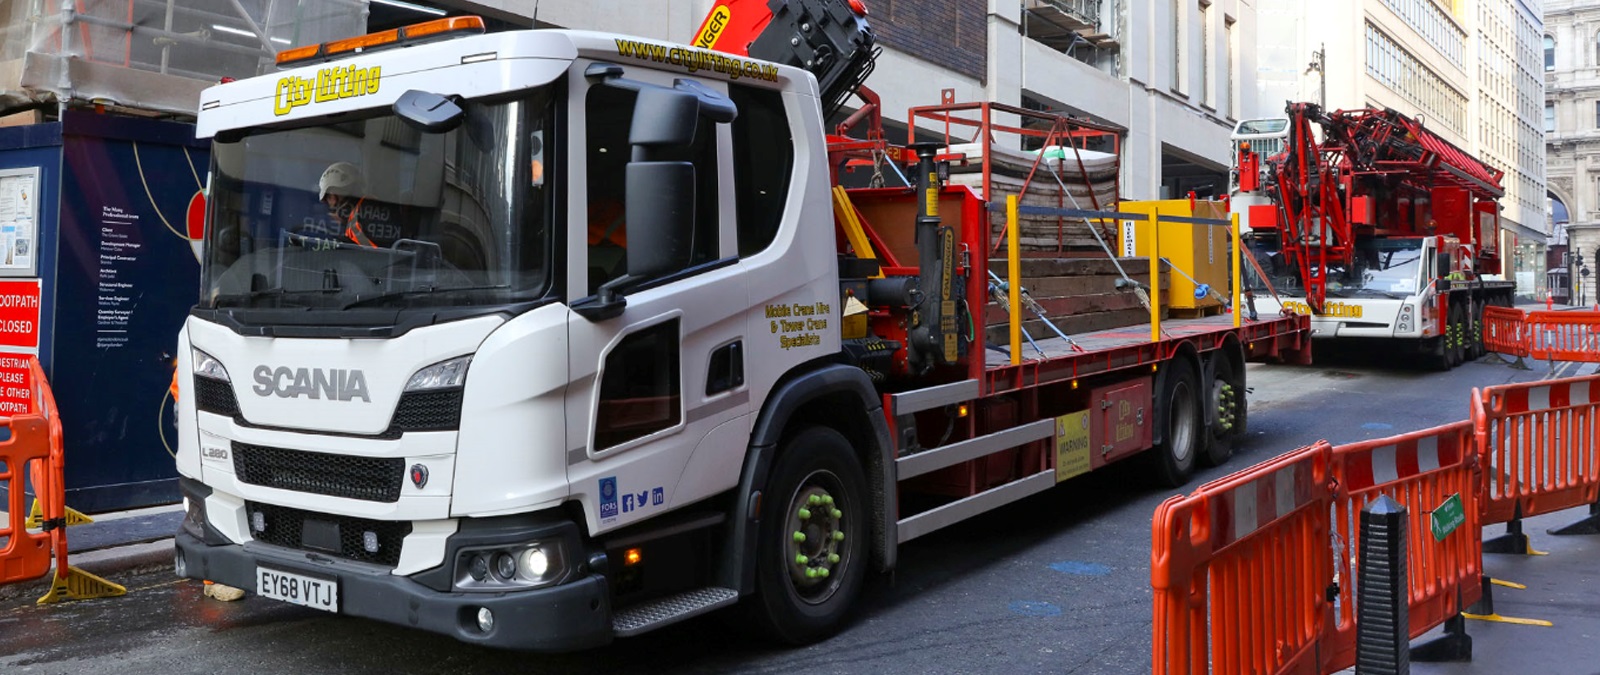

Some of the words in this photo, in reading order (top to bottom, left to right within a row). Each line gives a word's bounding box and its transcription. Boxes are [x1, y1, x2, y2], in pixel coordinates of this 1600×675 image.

[615, 38, 779, 82] www.citylifting.co.uk
[274, 76, 315, 116] City
[315, 63, 381, 103] Lifting
[765, 304, 791, 319] Mobile
[793, 303, 814, 317] Crane
[816, 301, 830, 315] Hire
[1314, 301, 1363, 318] ifting
[770, 320, 778, 334] &
[780, 318, 805, 333] Tower
[807, 317, 828, 331] Crane
[780, 333, 820, 351] Specialists
[0, 358, 31, 369] ESTRIAN
[252, 365, 371, 402] SCANIA
[6, 387, 31, 399] OTHER
[0, 401, 28, 414] OTPATH
[1060, 436, 1088, 454] WARNING
[262, 571, 298, 599] EY68
[303, 580, 331, 606] VTJ
